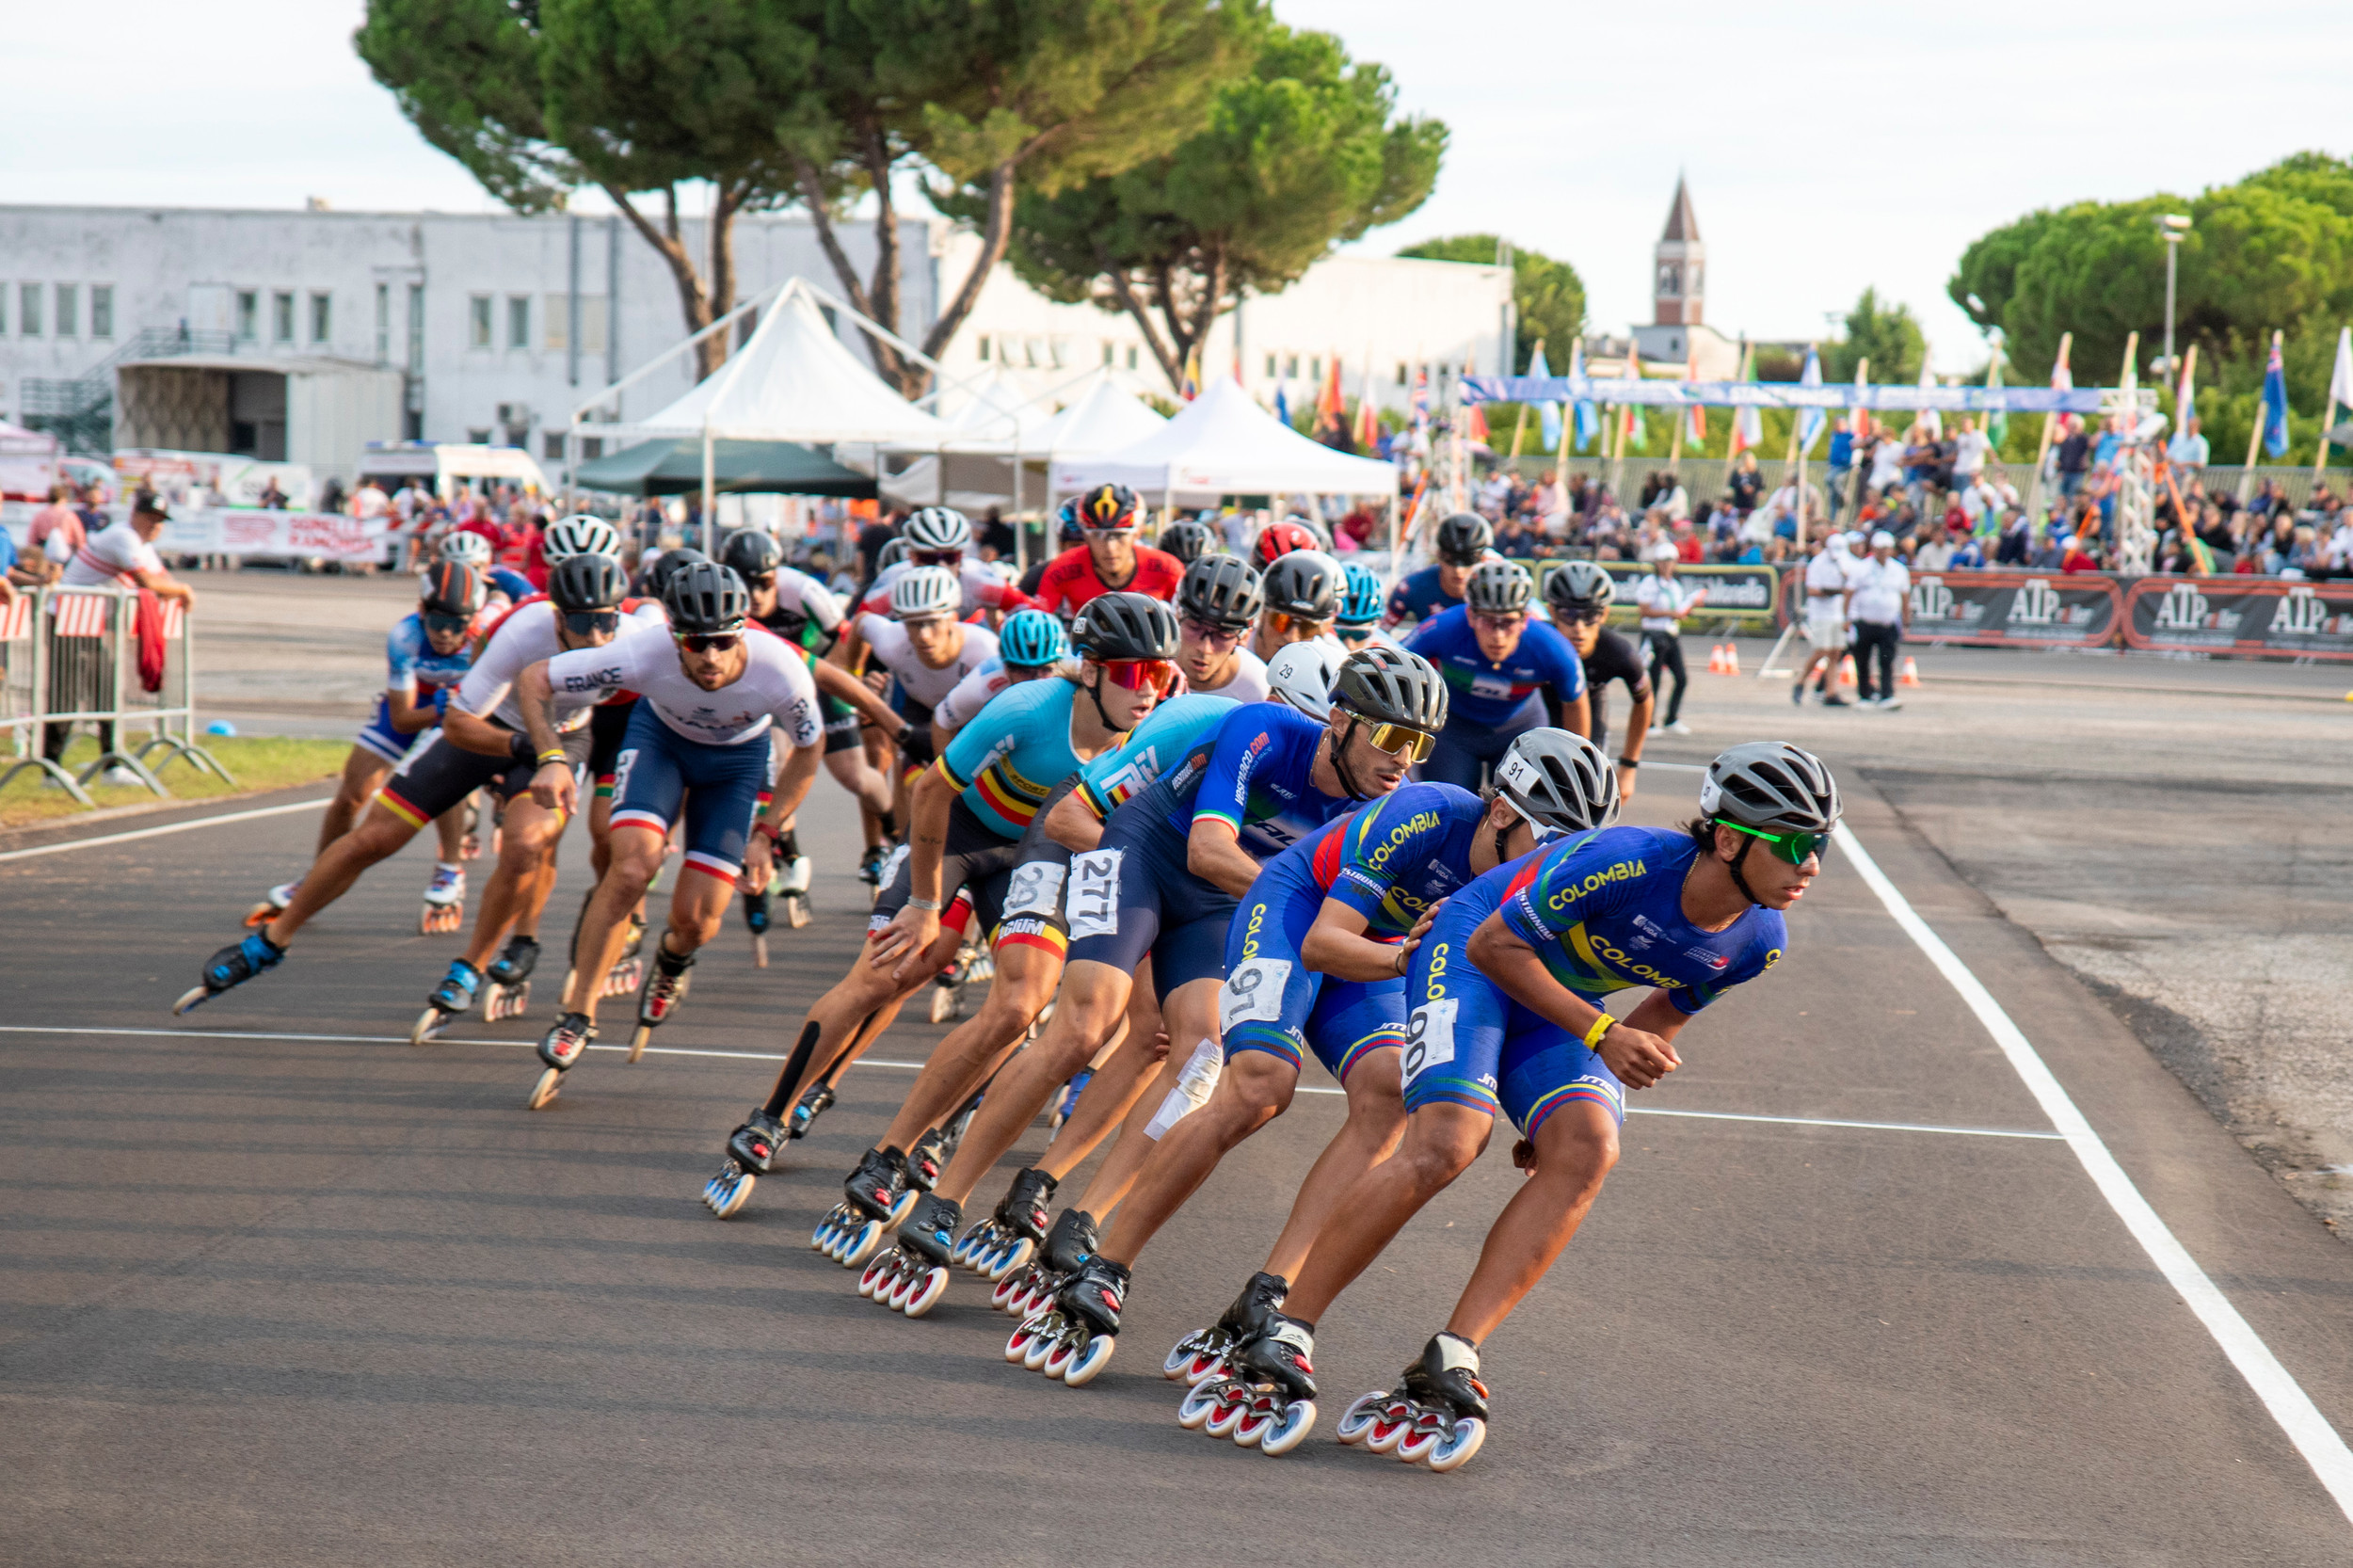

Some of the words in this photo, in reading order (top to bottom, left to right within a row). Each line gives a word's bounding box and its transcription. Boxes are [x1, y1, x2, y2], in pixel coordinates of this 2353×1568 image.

[565, 666, 623, 693] FRANCE
[1278, 664, 1293, 679] 29
[1508, 761, 1524, 781] 91
[1368, 810, 1440, 871] COLOMBIA
[1009, 867, 1043, 909] 29
[1079, 857, 1112, 921] 277
[1391, 886, 1432, 913] COL
[1548, 858, 1647, 911] COLOMBIA
[1228, 968, 1262, 1019] 91
[1426, 943, 1449, 1002] COLO
[1405, 1010, 1428, 1078] 90
